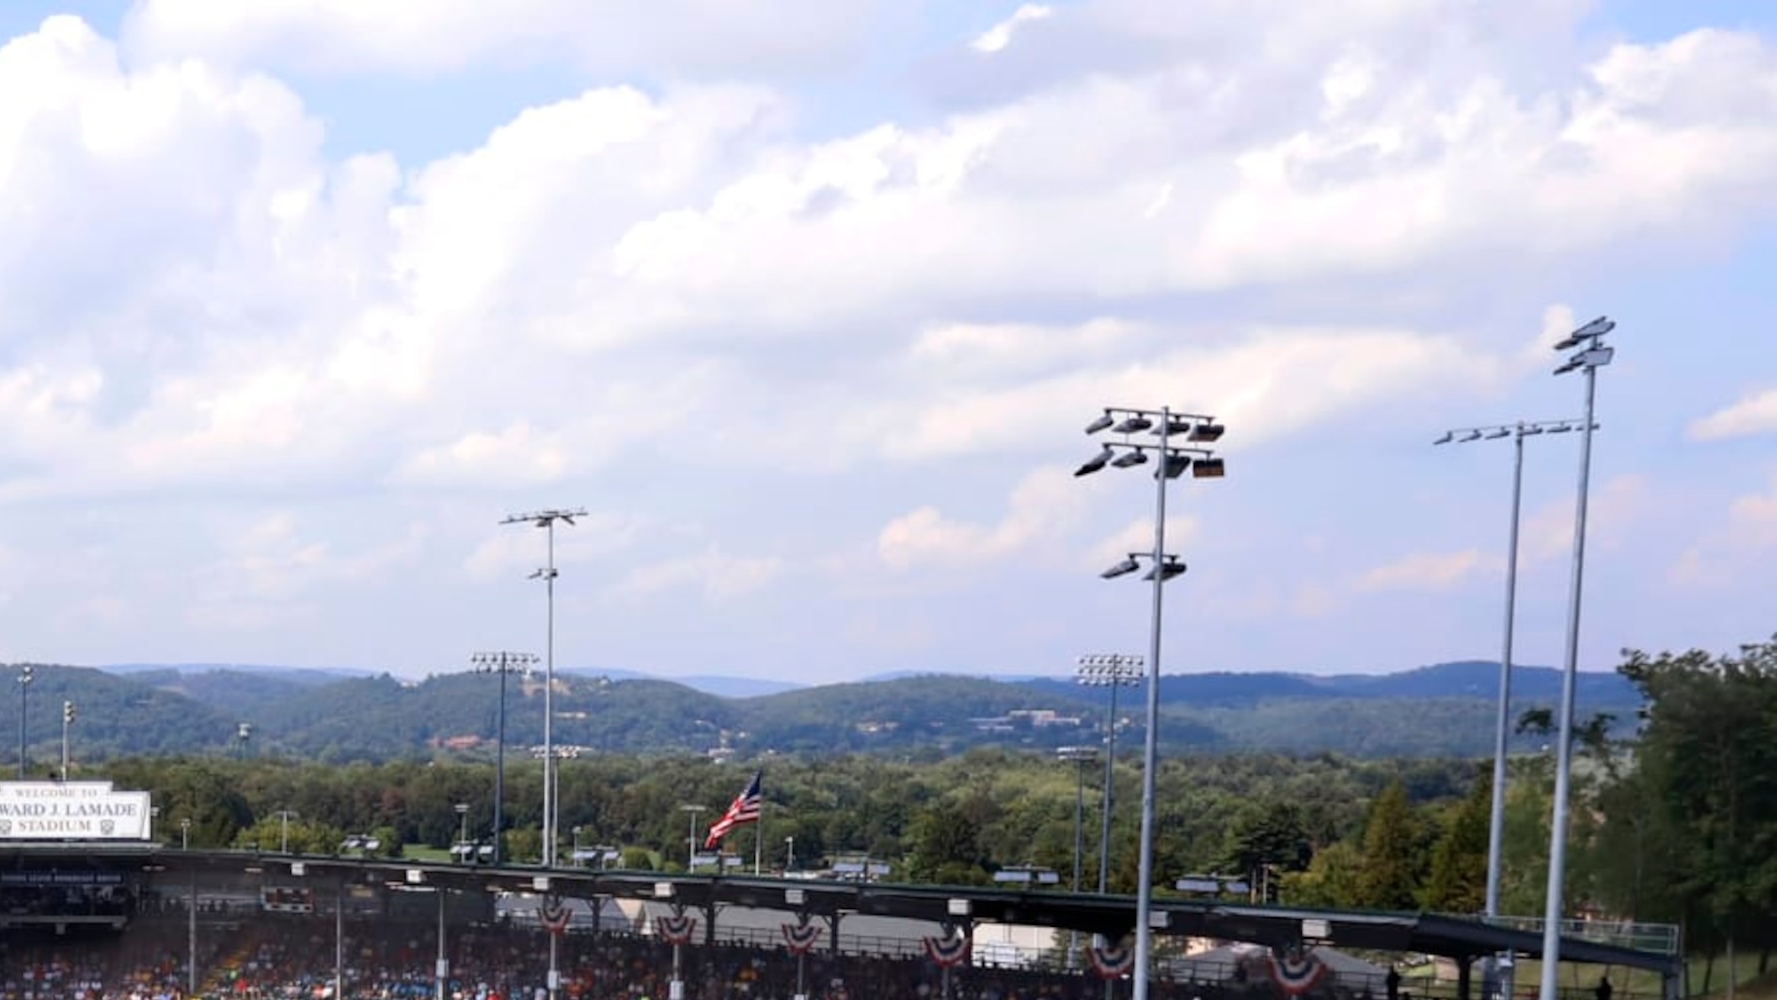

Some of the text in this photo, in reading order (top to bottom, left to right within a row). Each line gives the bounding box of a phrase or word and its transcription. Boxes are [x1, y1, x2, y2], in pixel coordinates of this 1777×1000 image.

[15, 788, 98, 799] WELCOME TO
[50, 803, 61, 816] J.
[65, 803, 137, 816] LAMADE
[18, 819, 92, 832] STADIUM
